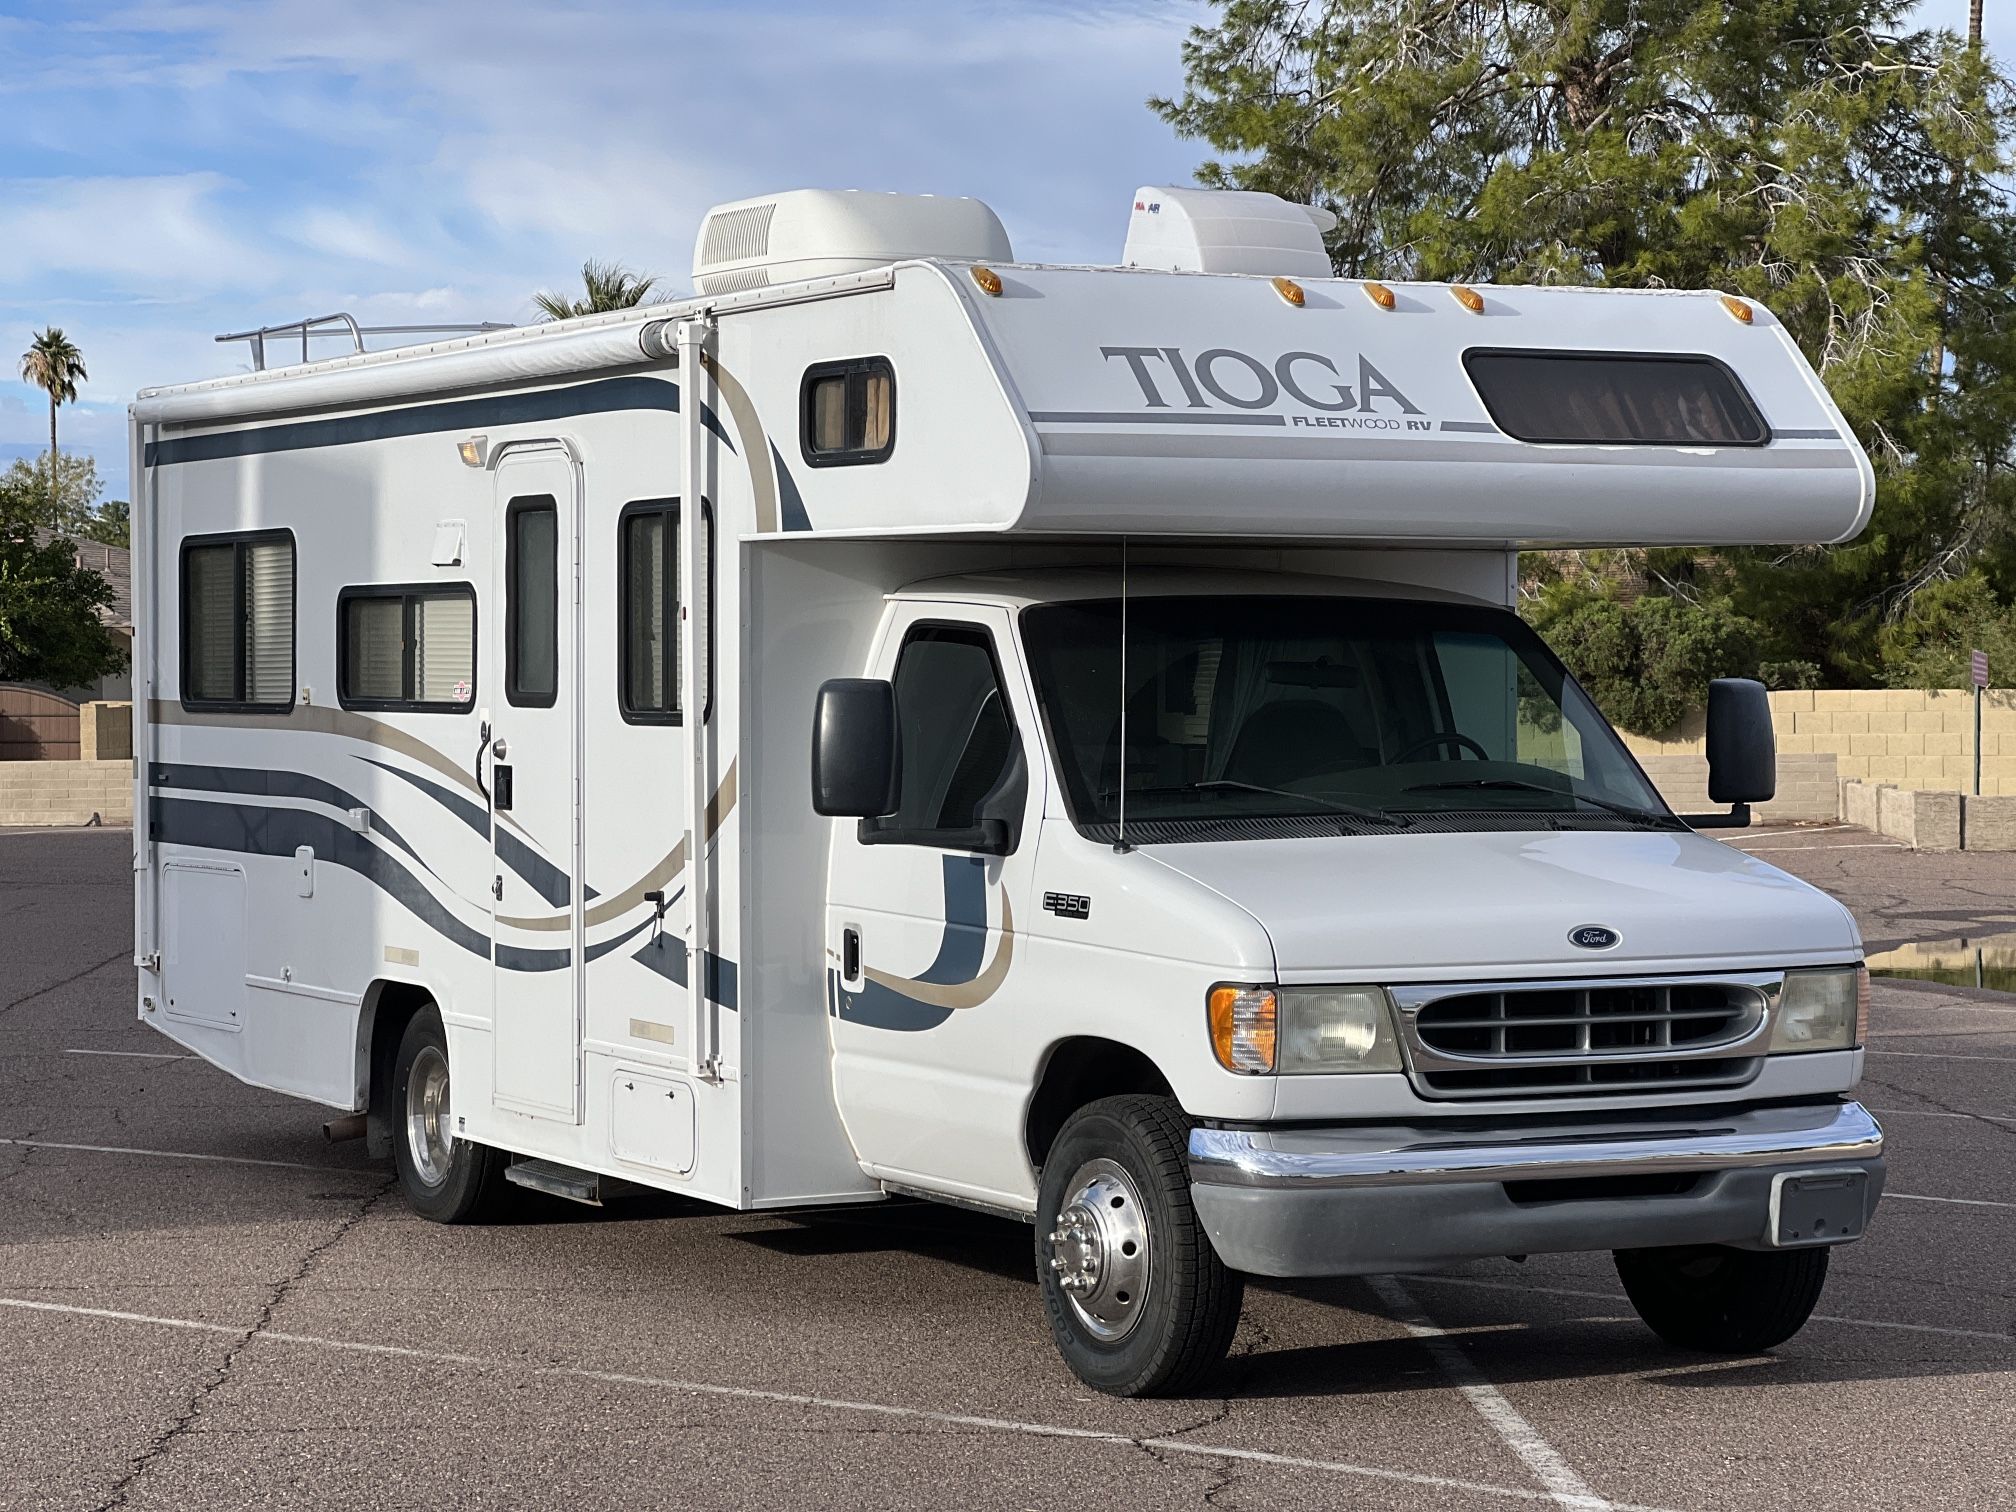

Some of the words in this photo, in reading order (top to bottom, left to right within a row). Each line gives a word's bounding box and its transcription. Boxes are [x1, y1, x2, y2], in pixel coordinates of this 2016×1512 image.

[1099, 346, 1428, 416] TIOGA
[1292, 416, 1401, 430] FLEETWOOD
[1406, 420, 1432, 431] RV
[1582, 930, 1608, 943] Ford
